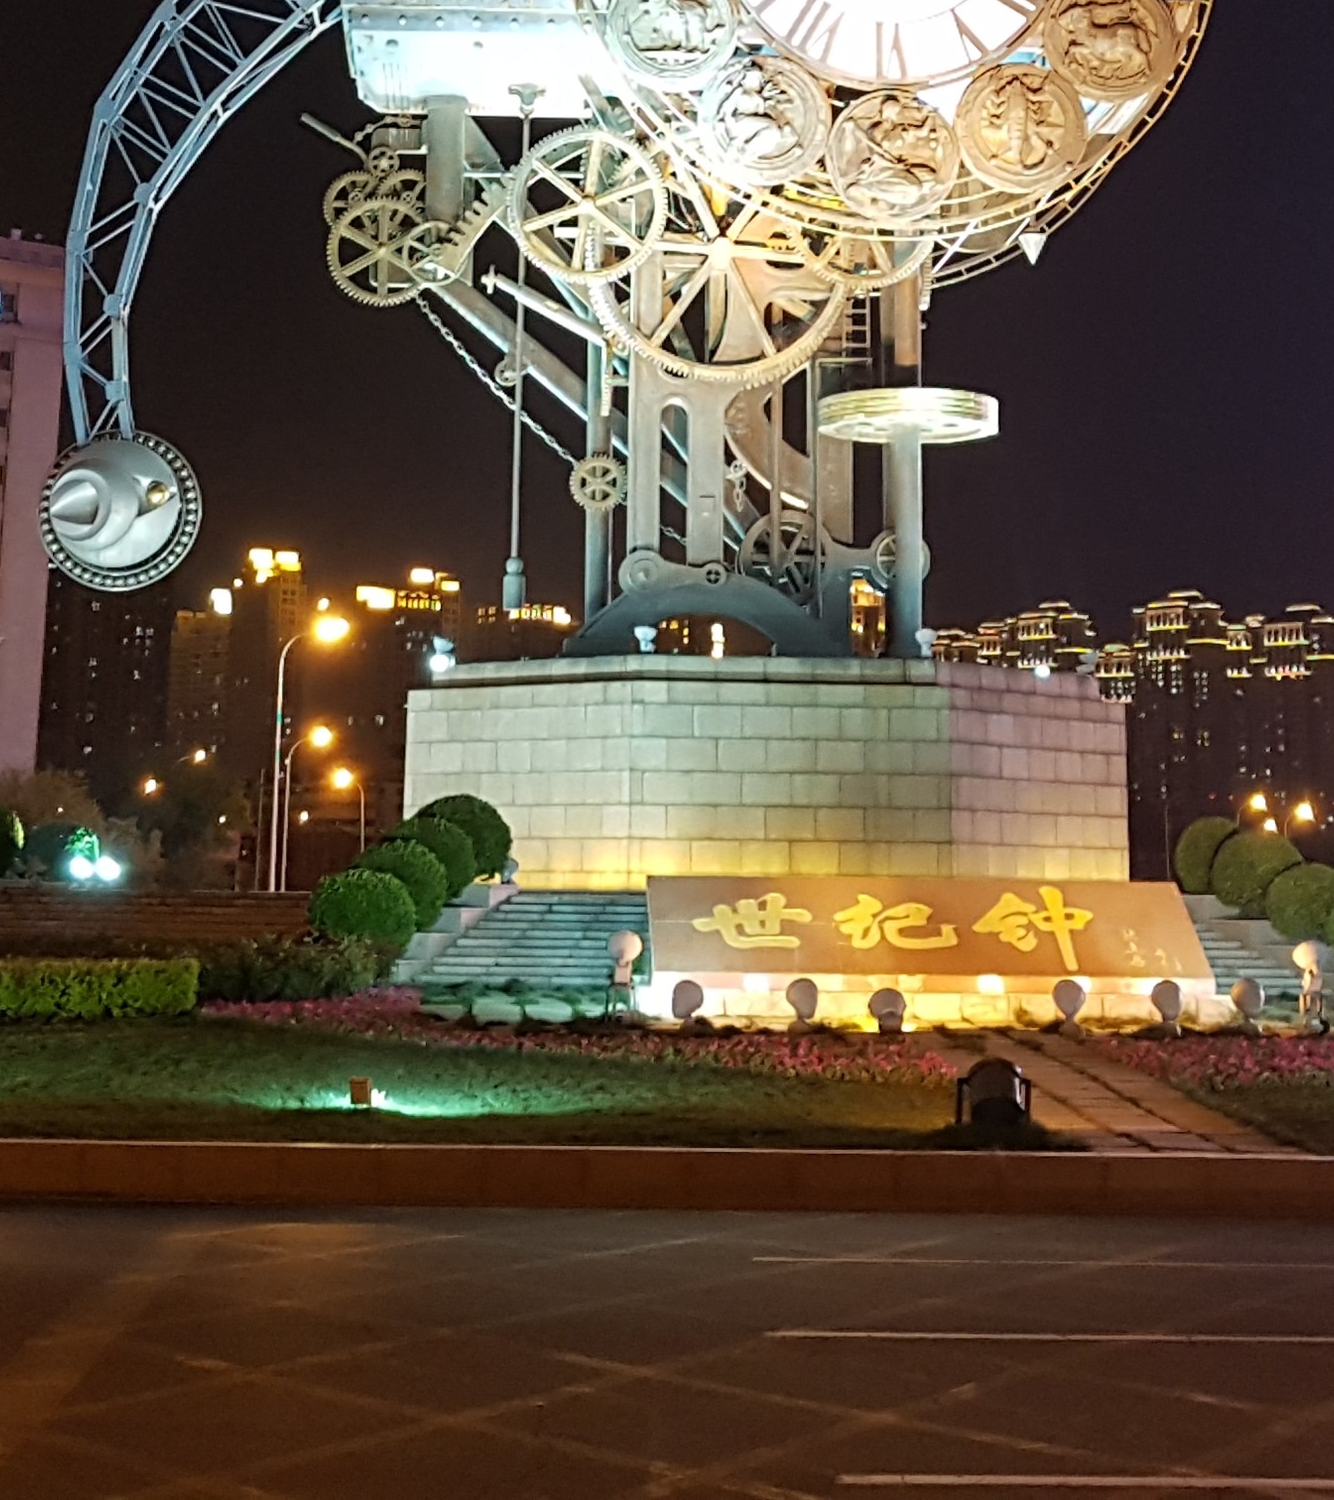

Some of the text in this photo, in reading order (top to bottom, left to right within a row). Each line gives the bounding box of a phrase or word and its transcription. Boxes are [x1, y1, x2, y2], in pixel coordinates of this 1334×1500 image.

[875, 21, 909, 80] VI
[951, 8, 990, 64] V
[692, 885, 1094, 972] 世纪钟
